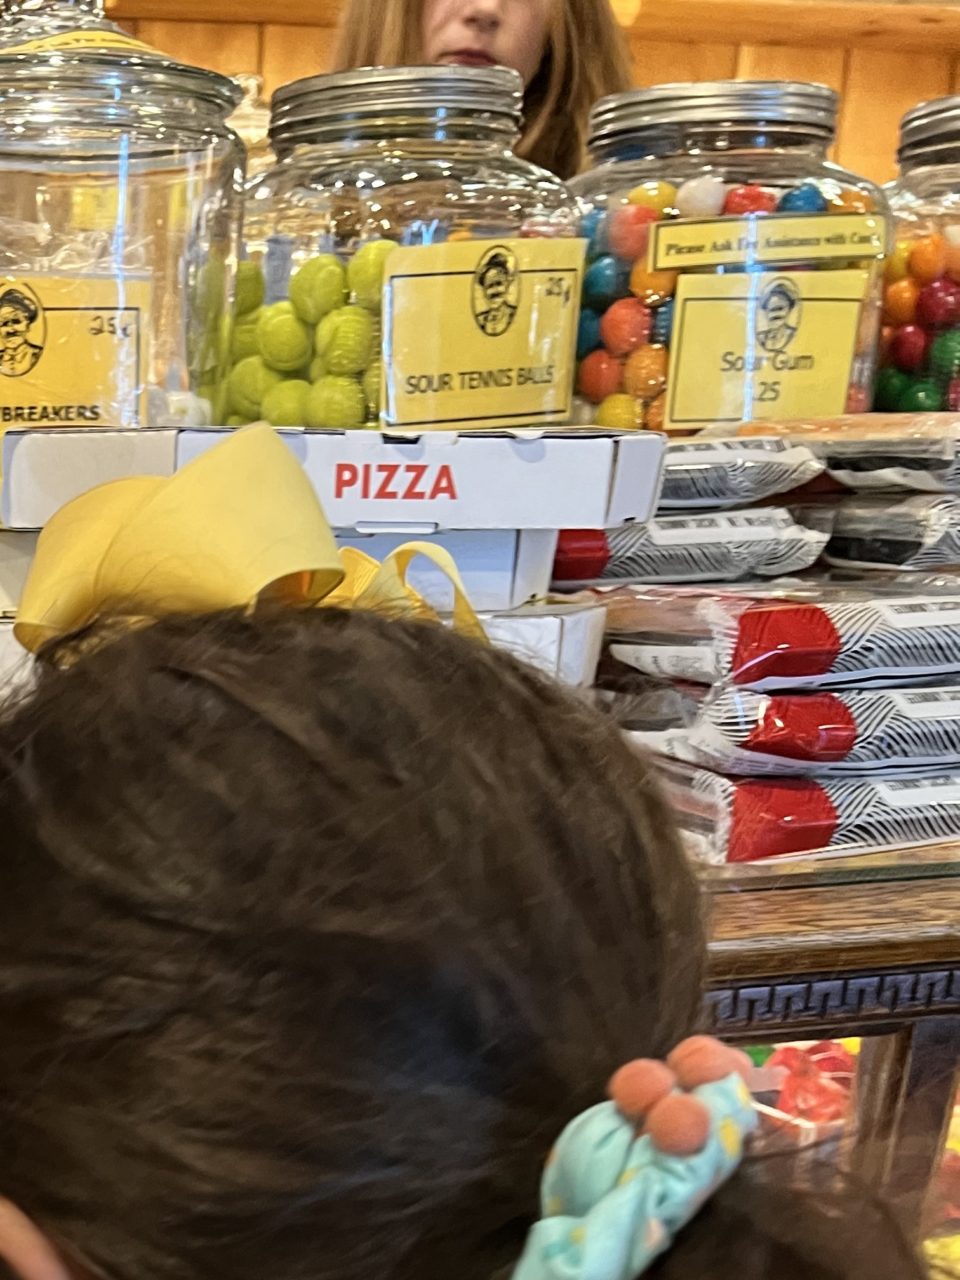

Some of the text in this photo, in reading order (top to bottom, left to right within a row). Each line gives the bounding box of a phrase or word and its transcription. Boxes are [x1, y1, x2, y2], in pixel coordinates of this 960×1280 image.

[772, 350, 815, 371] Gum
[405, 364, 555, 395] SOUR TENNIS BALLS
[334, 463, 458, 500] PIZZA
